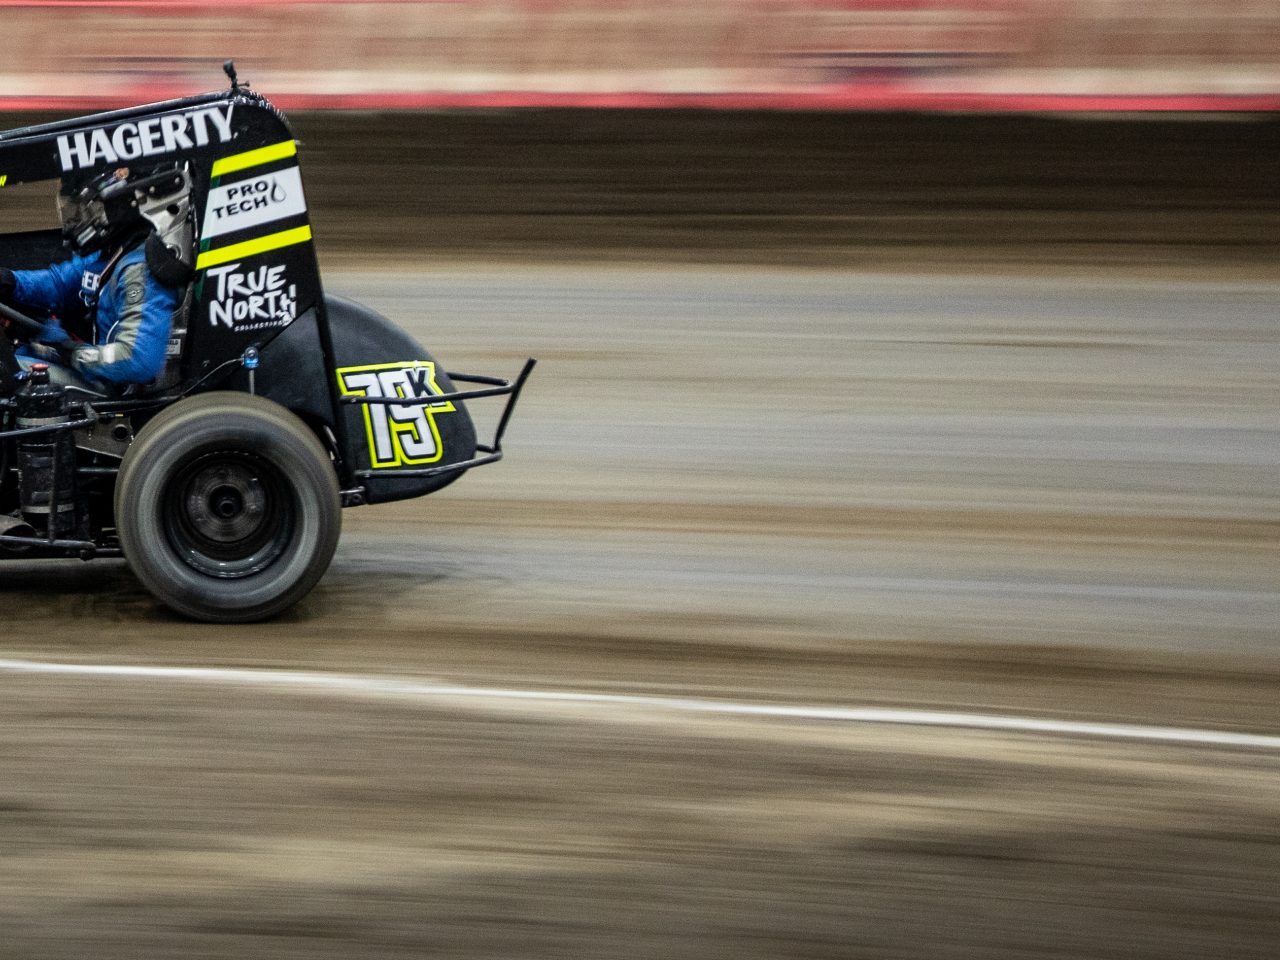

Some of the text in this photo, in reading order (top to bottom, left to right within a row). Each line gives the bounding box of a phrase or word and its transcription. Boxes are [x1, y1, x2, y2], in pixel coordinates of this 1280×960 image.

[56, 101, 235, 172] HAGERTY
[212, 195, 268, 219] TECH
[227, 180, 269, 200] PRO
[206, 262, 287, 303] TRUE
[209, 284, 297, 328] NORTH
